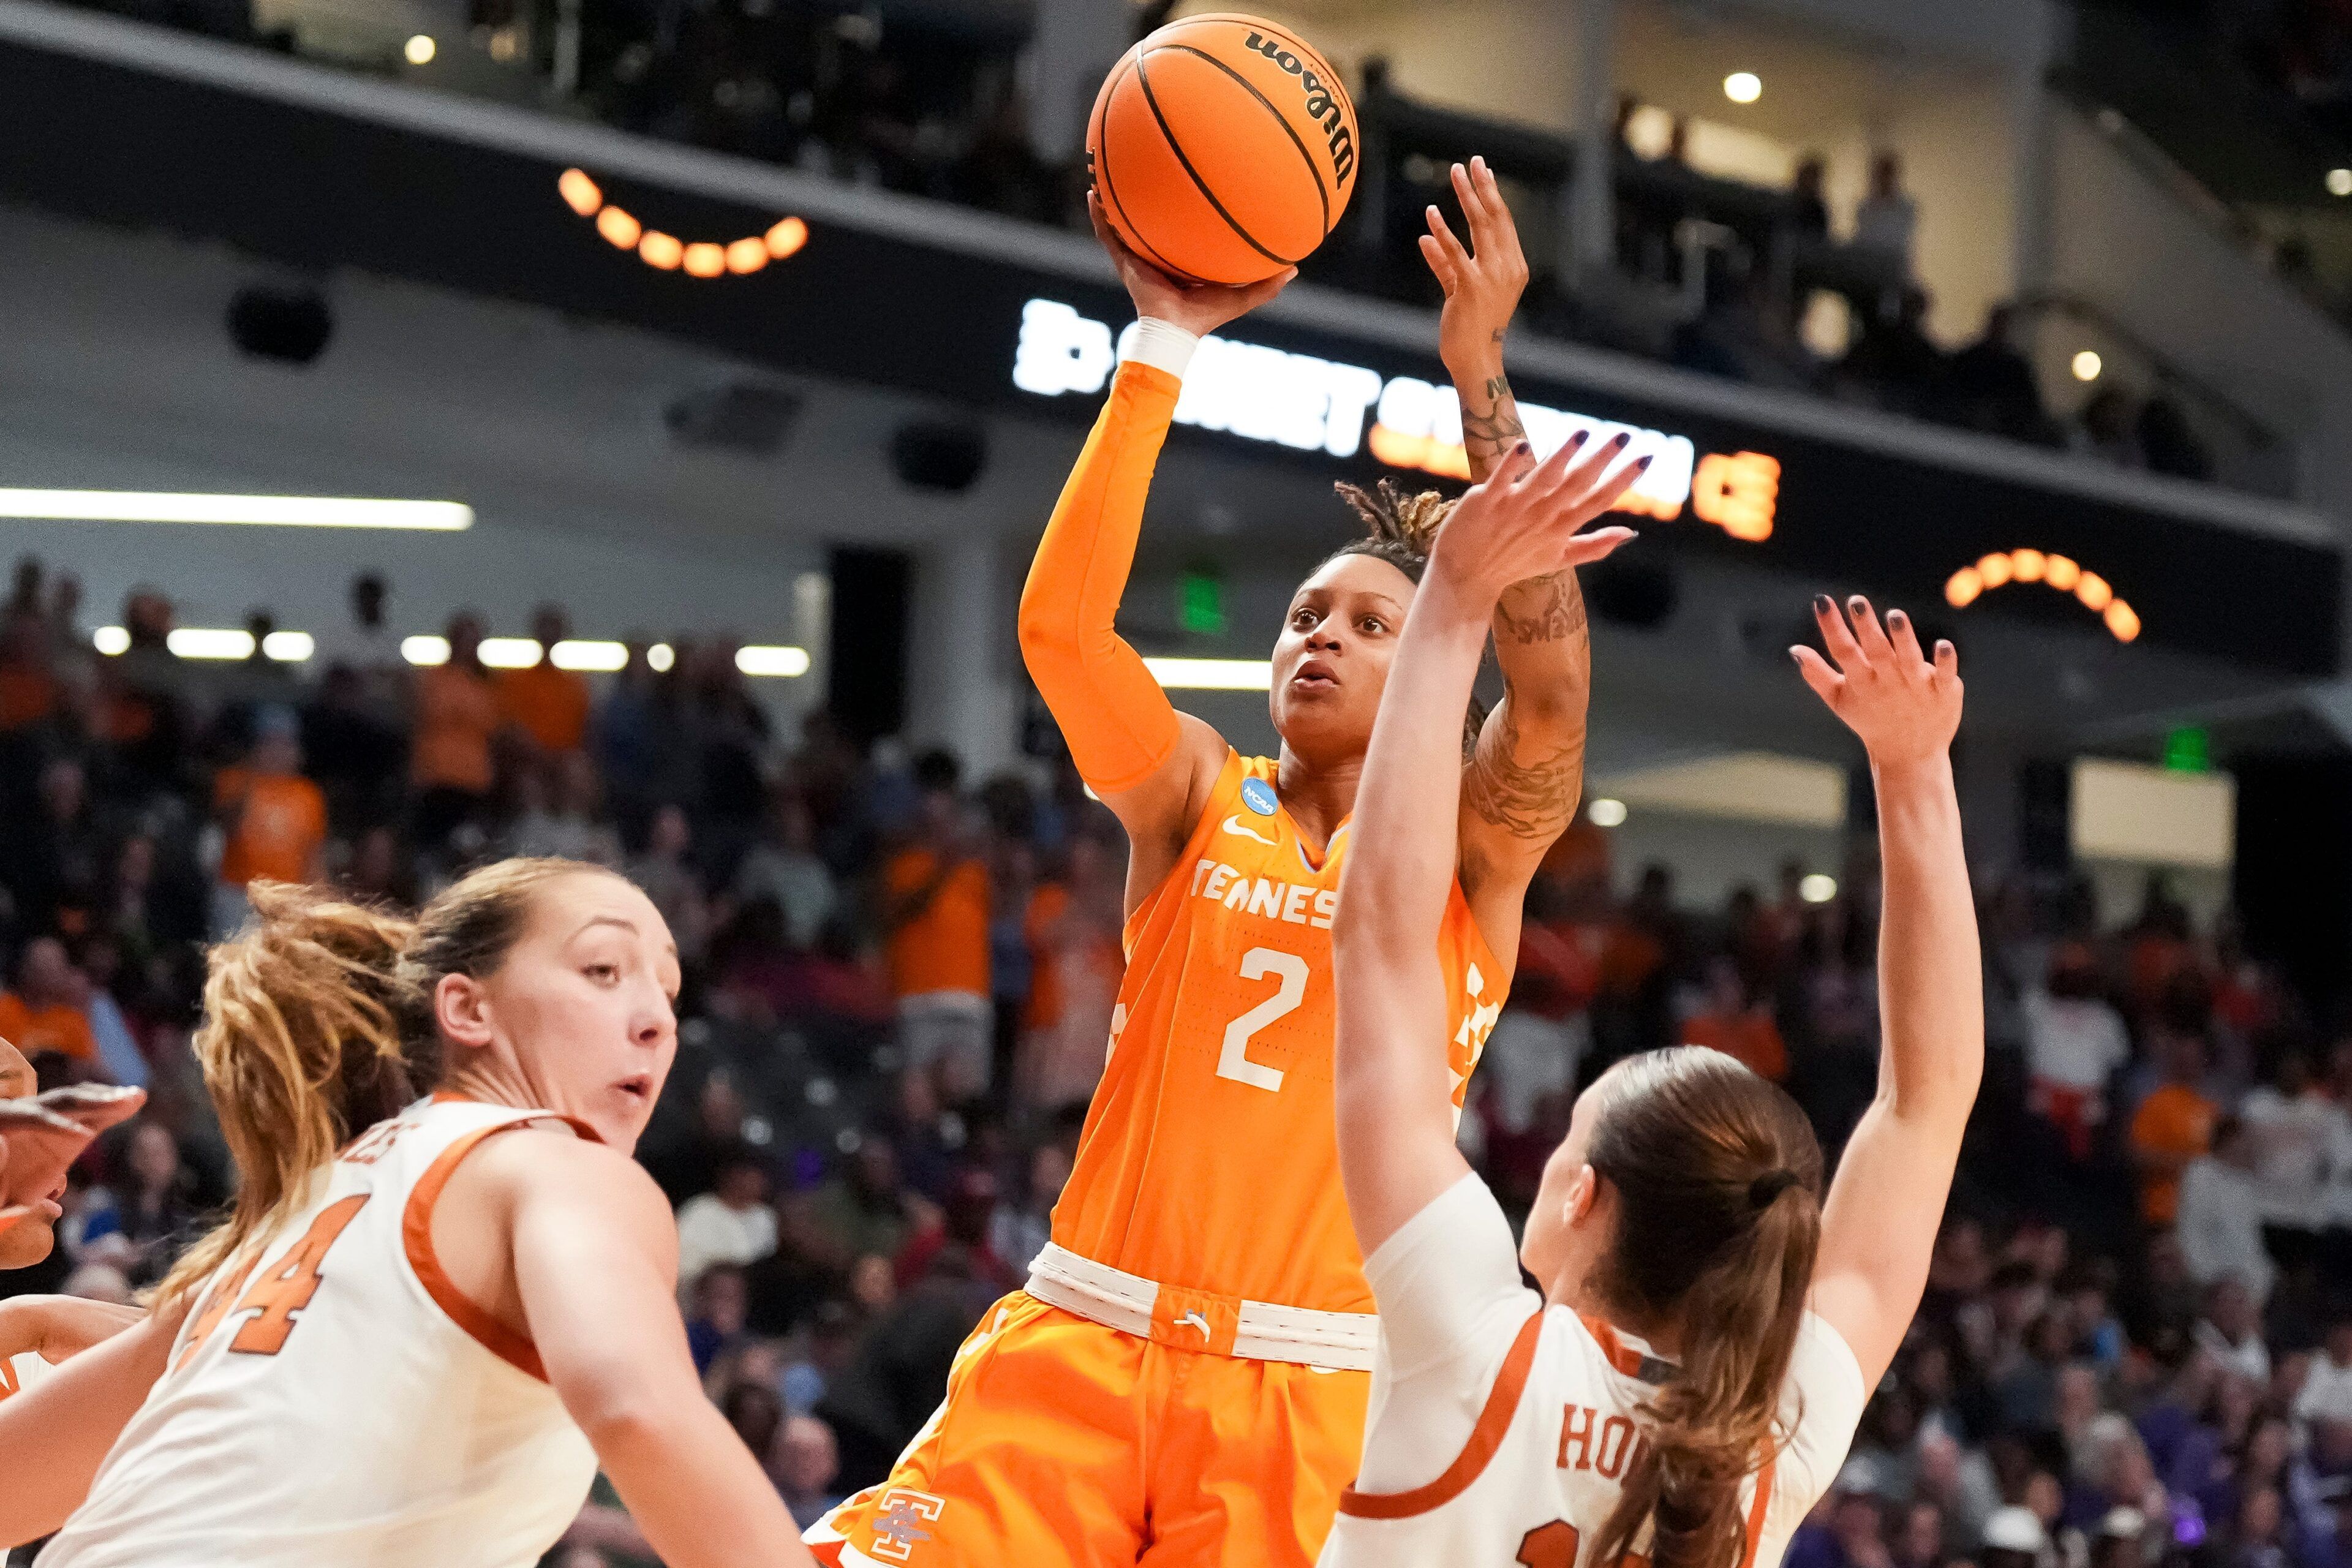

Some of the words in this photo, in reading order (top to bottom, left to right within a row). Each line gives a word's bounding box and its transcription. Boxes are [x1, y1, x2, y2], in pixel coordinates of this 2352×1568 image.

[1245, 31, 1354, 191] Wilson
[1243, 785, 1275, 815] NCAA
[1190, 859, 1338, 930] TENNES
[1216, 946, 1310, 1093] 2
[1556, 1403, 1643, 1481] HO
